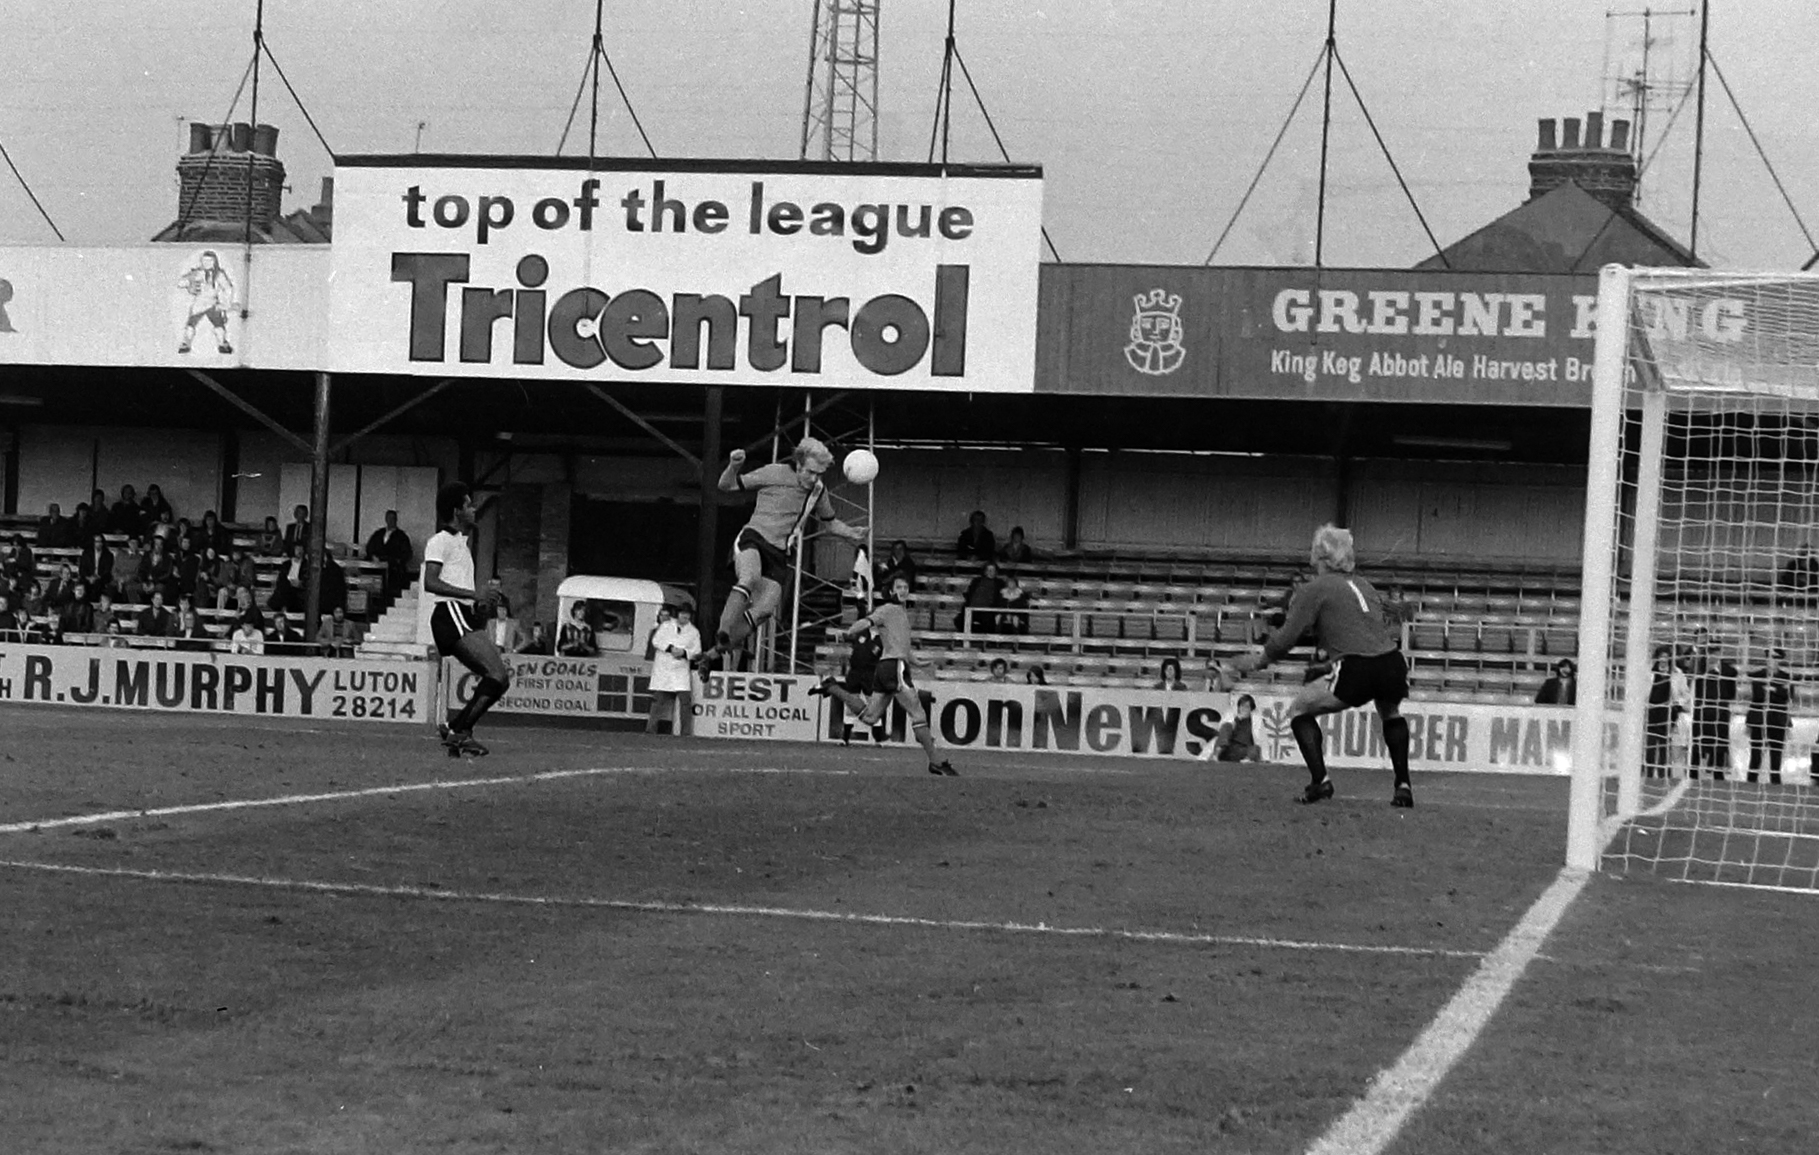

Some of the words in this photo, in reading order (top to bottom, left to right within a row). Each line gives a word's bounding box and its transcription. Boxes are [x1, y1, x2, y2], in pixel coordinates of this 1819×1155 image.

[402, 184, 514, 244] top
[532, 179, 600, 231] of
[622, 180, 730, 235] the
[749, 182, 975, 254] league
[390, 252, 970, 377] Tricentrol
[1272, 288, 1546, 338] GREENE
[1570, 294, 1748, 342] KNG
[1271, 349, 1318, 382] King
[1322, 350, 1362, 383] Keg
[1369, 351, 1429, 378] Abbot
[1433, 353, 1464, 379] Ale
[1473, 354, 1558, 381] Harvest
[1565, 356, 1636, 383] Brn
[542, 660, 598, 677] GOALS
[334, 669, 417, 694] LUTON
[516, 677, 552, 690] FIRST
[555, 678, 591, 692] GOAL
[703, 676, 798, 703] BEST
[332, 696, 415, 719] 28214
[498, 696, 551, 709] SECOND
[554, 699, 591, 712] GOAL
[692, 703, 717, 717] OR
[721, 705, 749, 719] ALL
[756, 706, 810, 721] LOCAL
[718, 722, 776, 736] SPORT
